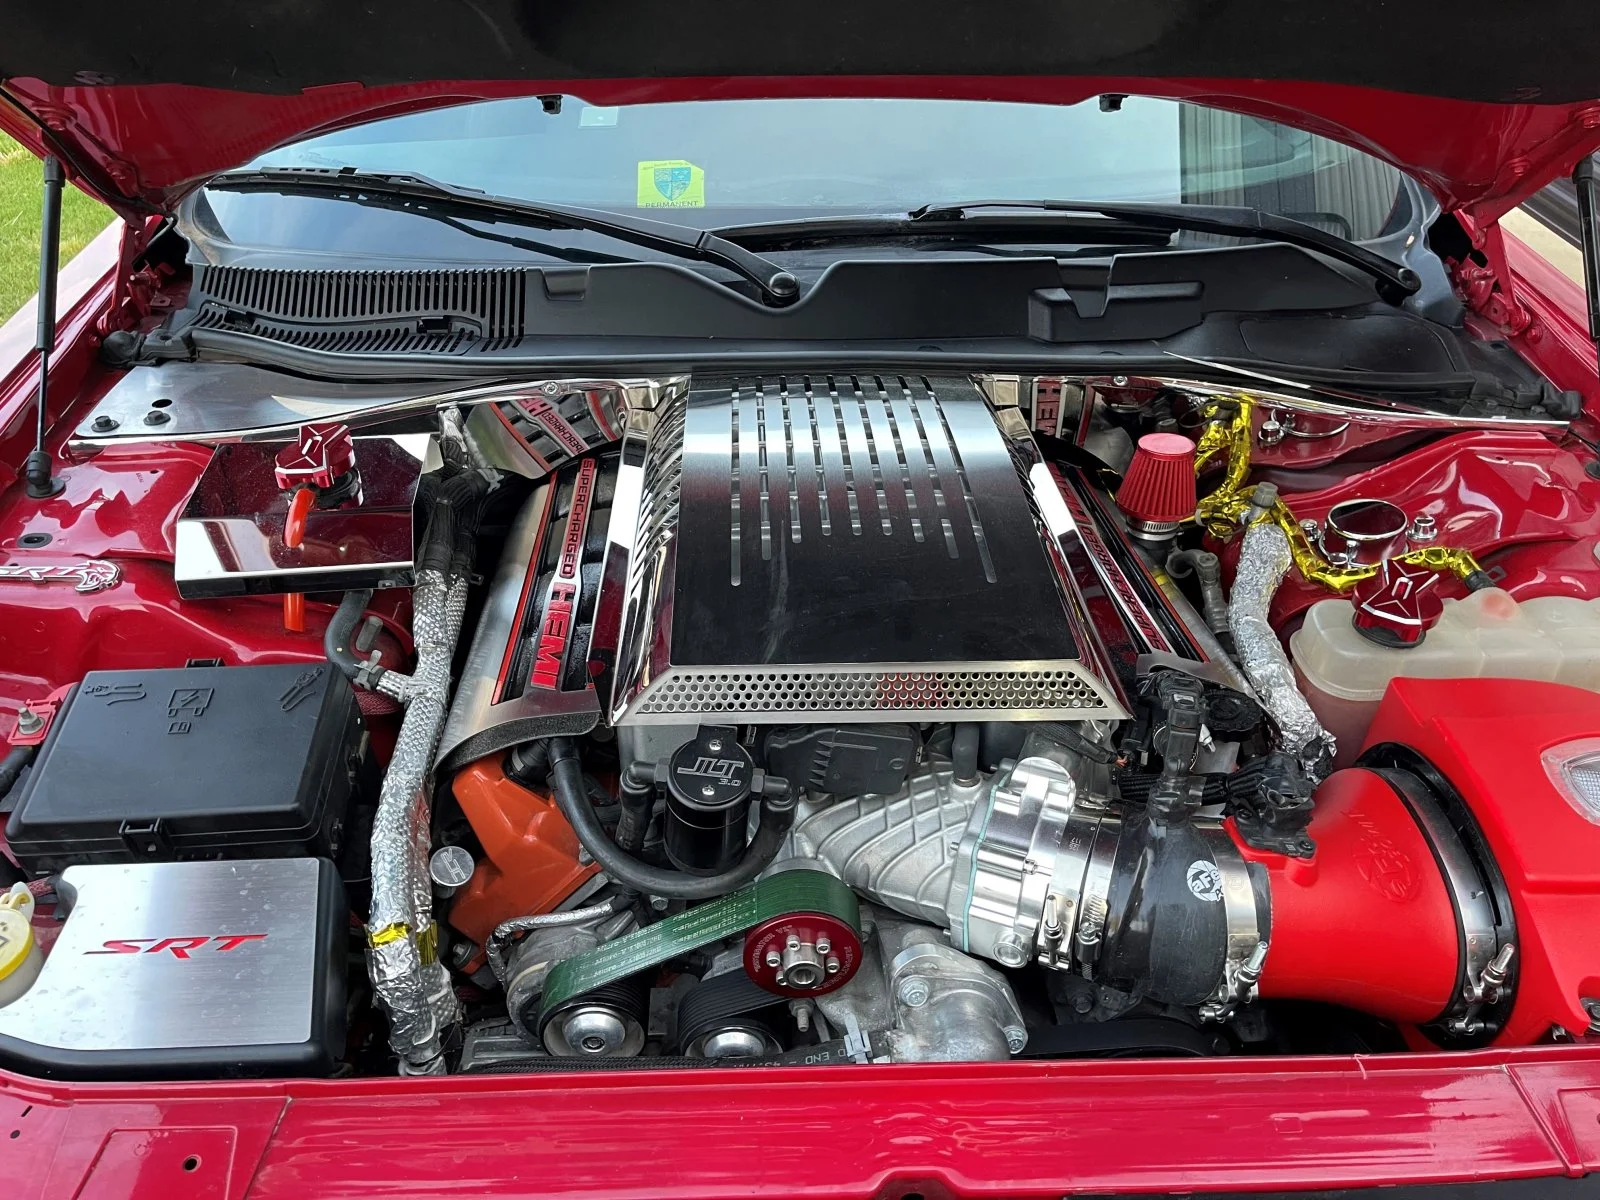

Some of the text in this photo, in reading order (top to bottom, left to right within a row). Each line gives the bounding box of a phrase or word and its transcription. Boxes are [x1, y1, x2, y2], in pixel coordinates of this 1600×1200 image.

[645, 200, 698, 208] PERMANENT
[531, 459, 595, 690] SUPERCHARGED HEMI
[1080, 526, 1172, 653] SUPERCHARGED
[677, 756, 745, 779] JLT
[718, 778, 742, 787] 3.0
[82, 933, 269, 959] SRT
[805, 1051, 830, 1065] END
